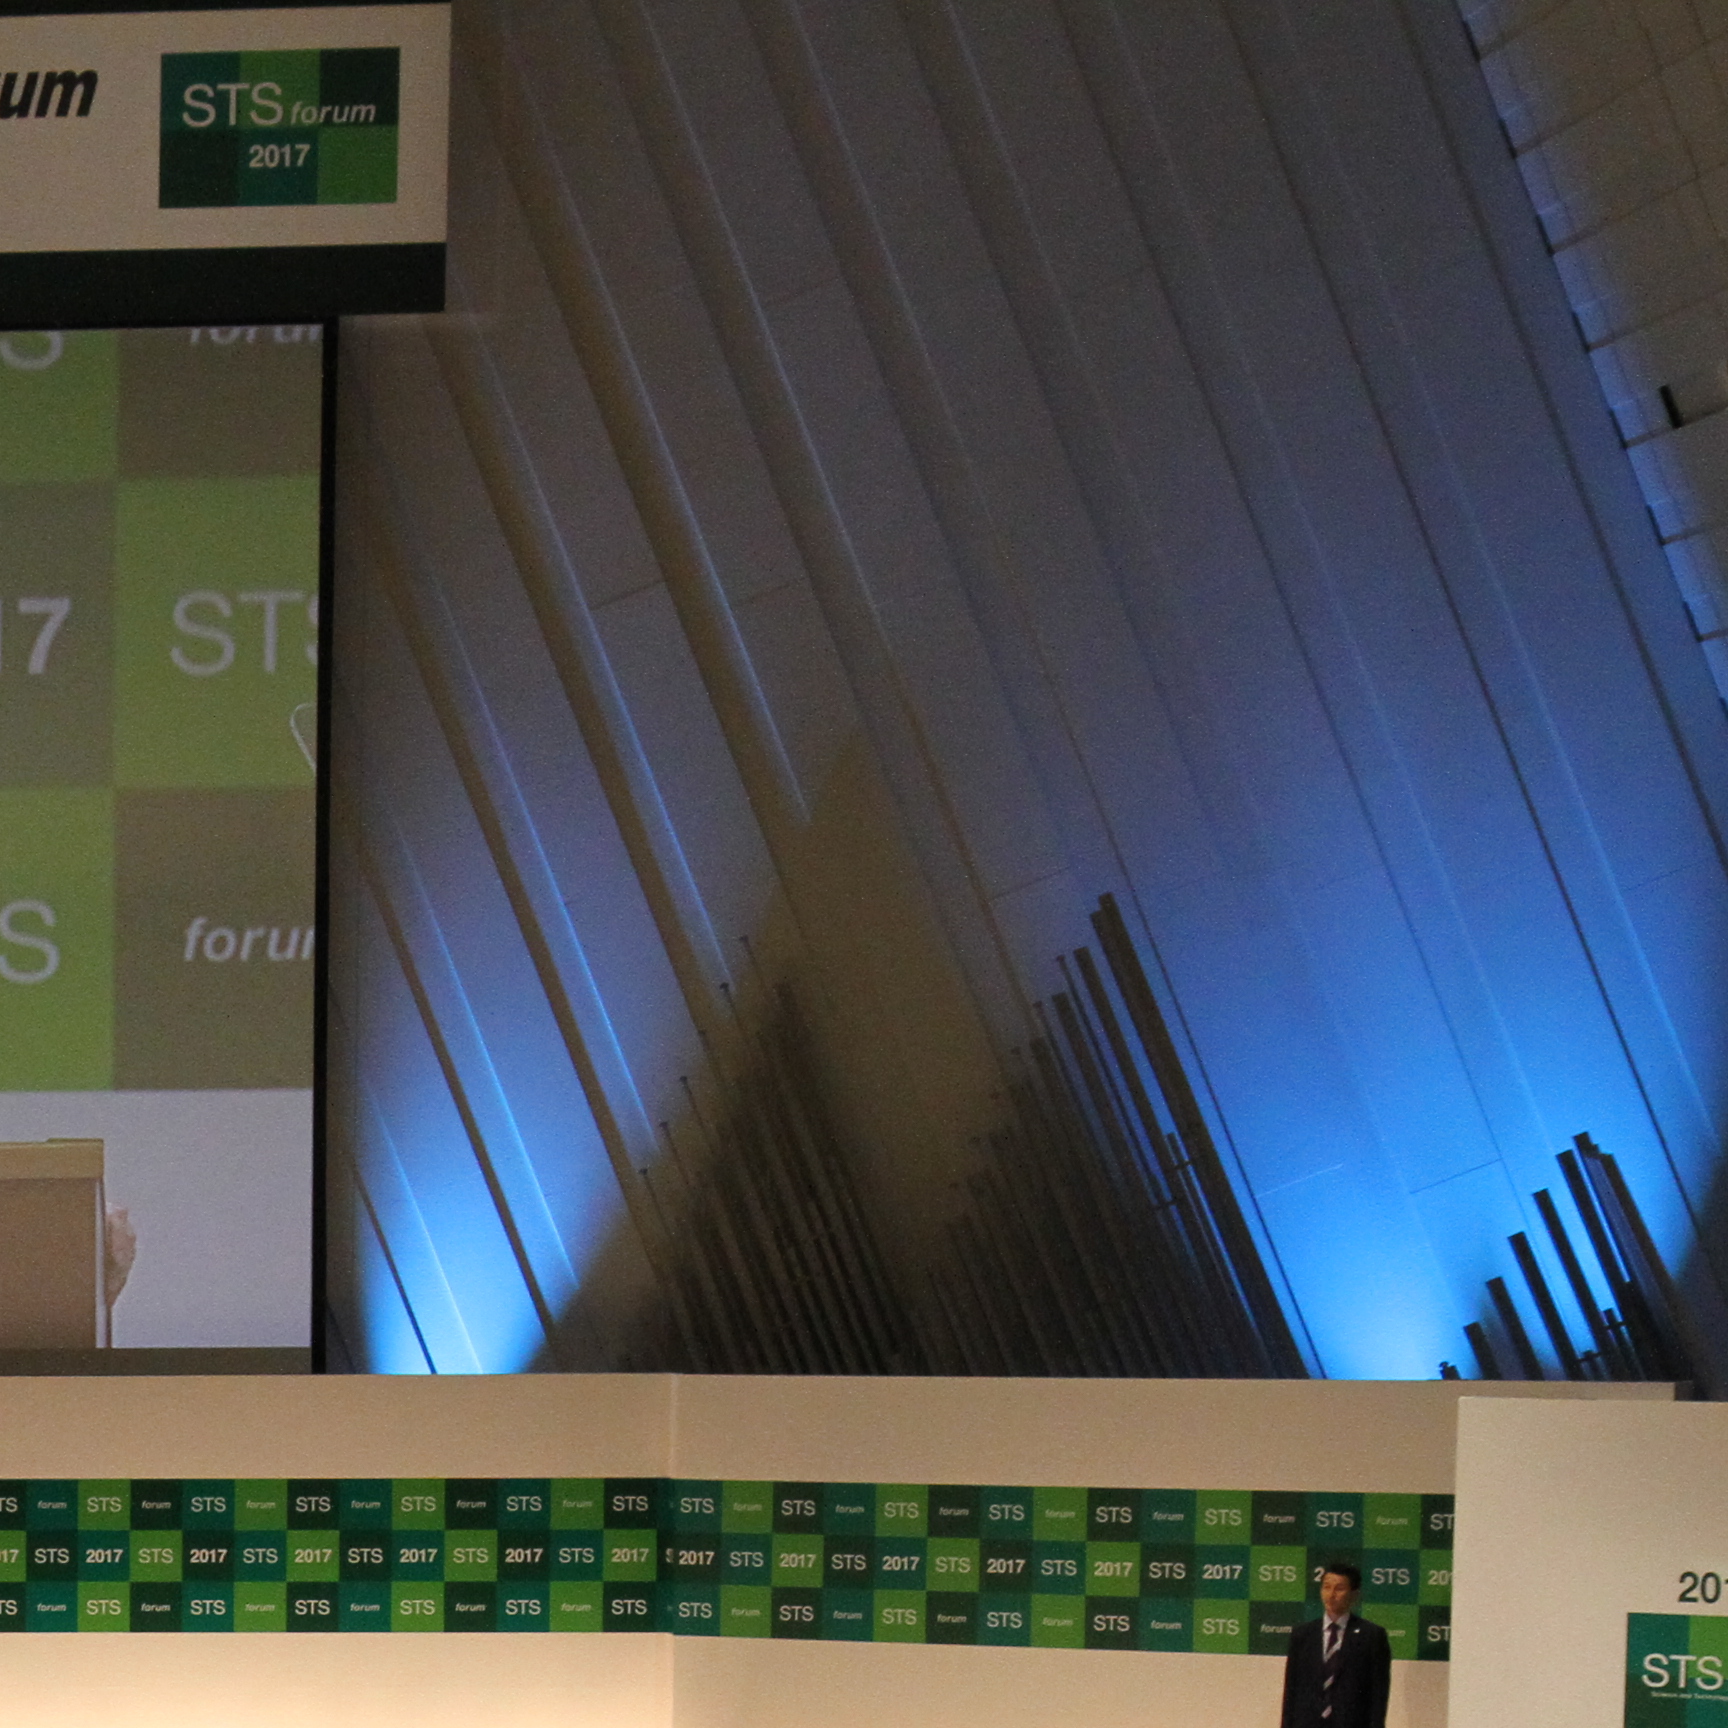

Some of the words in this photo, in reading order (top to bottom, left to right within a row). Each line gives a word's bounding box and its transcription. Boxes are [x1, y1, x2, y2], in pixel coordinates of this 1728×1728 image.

[183, 82, 283, 127] STS
[290, 101, 375, 125] forum
[250, 144, 310, 168] 2017
[170, 588, 317, 677] ST
[35, 1548, 69, 1563] STS
[86, 1549, 123, 1563] 2017
[139, 1548, 173, 1563] STS
[190, 1549, 227, 1563] 2017
[243, 1548, 278, 1563] STS
[295, 1549, 332, 1563] 2017
[348, 1548, 383, 1563] STS
[400, 1549, 437, 1562] 2017
[453, 1548, 488, 1563] STS
[505, 1548, 543, 1562] 2017
[559, 1548, 594, 1563] STS
[612, 1548, 649, 1562] 2017
[679, 1551, 714, 1565] 2017
[730, 1552, 763, 1567] STS
[780, 1553, 816, 1567] 2017
[832, 1554, 866, 1570] STS
[883, 1556, 920, 1570] 2017
[936, 1557, 971, 1573] STS
[987, 1559, 1025, 1573] 2017
[1042, 1560, 1077, 1575] STS
[1094, 1562, 1133, 1576] 2017
[1150, 1562, 1185, 1579] STS
[1203, 1564, 1242, 1579] 2017
[1259, 1565, 1296, 1582] STS
[1372, 1568, 1410, 1585] STS
[1642, 1653, 1724, 1690] STS
